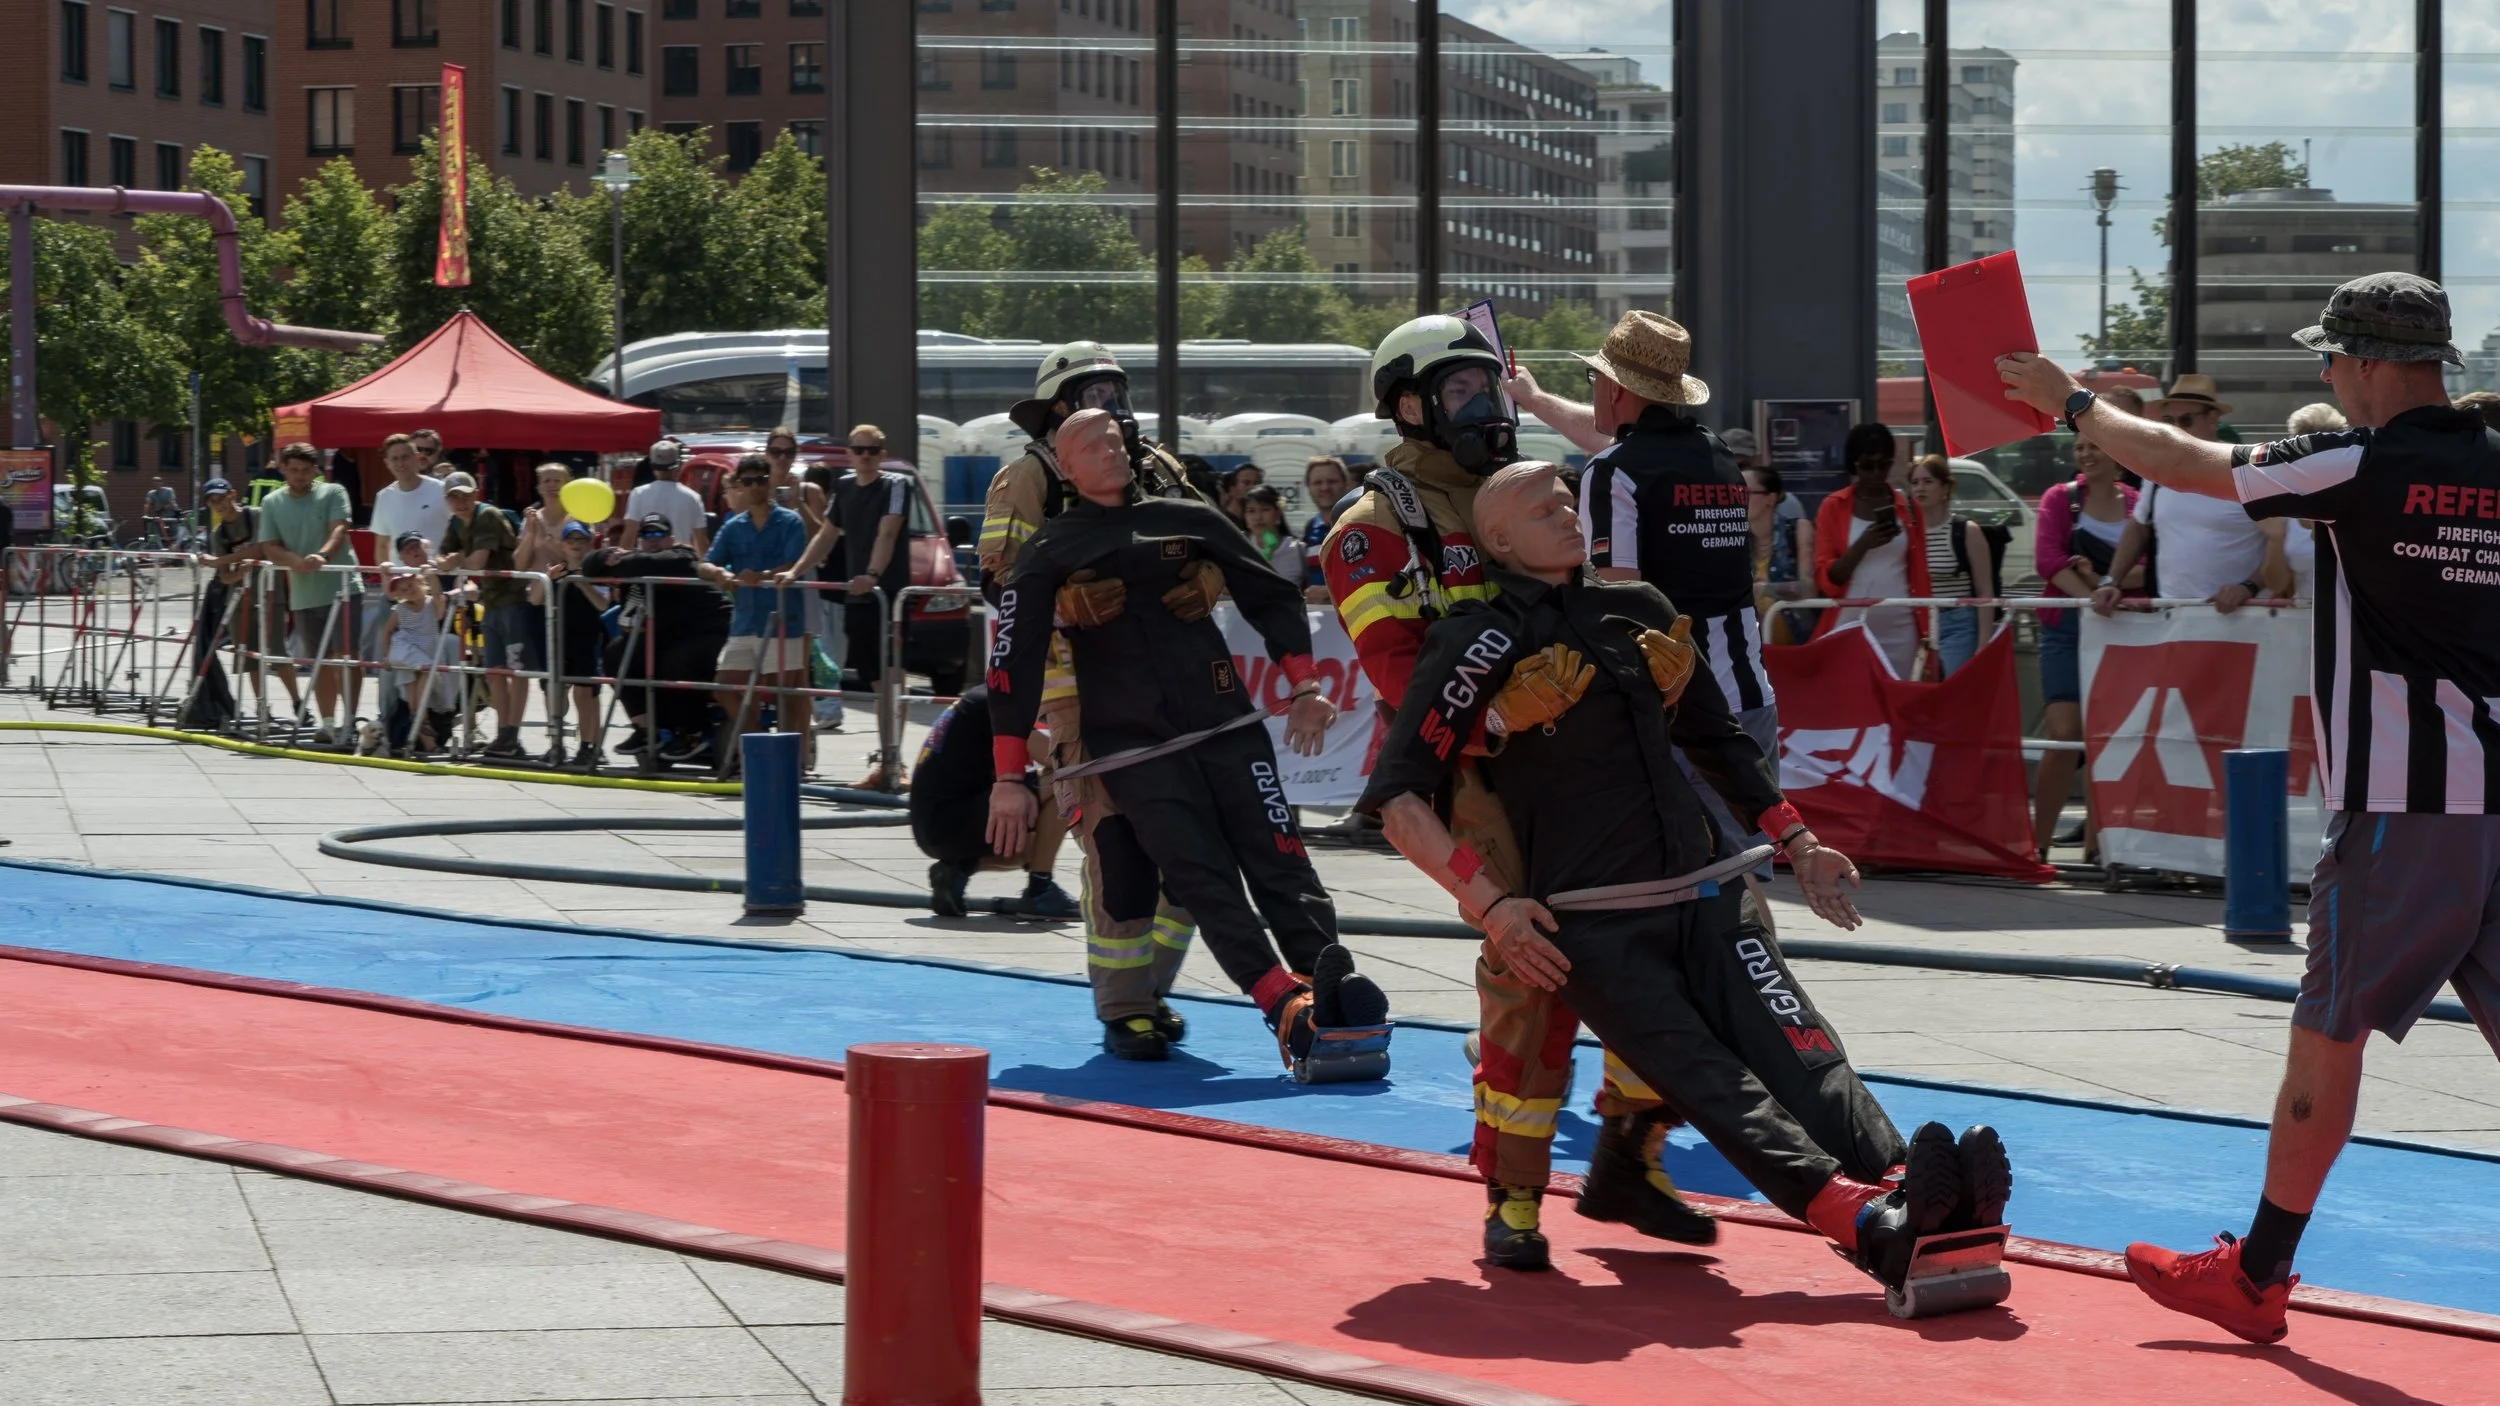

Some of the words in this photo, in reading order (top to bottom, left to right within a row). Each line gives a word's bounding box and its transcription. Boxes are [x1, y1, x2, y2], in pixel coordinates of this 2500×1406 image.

[2403, 484, 2500, 520] REFE
[1668, 523, 1717, 534] COMBAT
[1701, 536, 1746, 548] GERMANY
[2393, 541, 2471, 562] COMBAT
